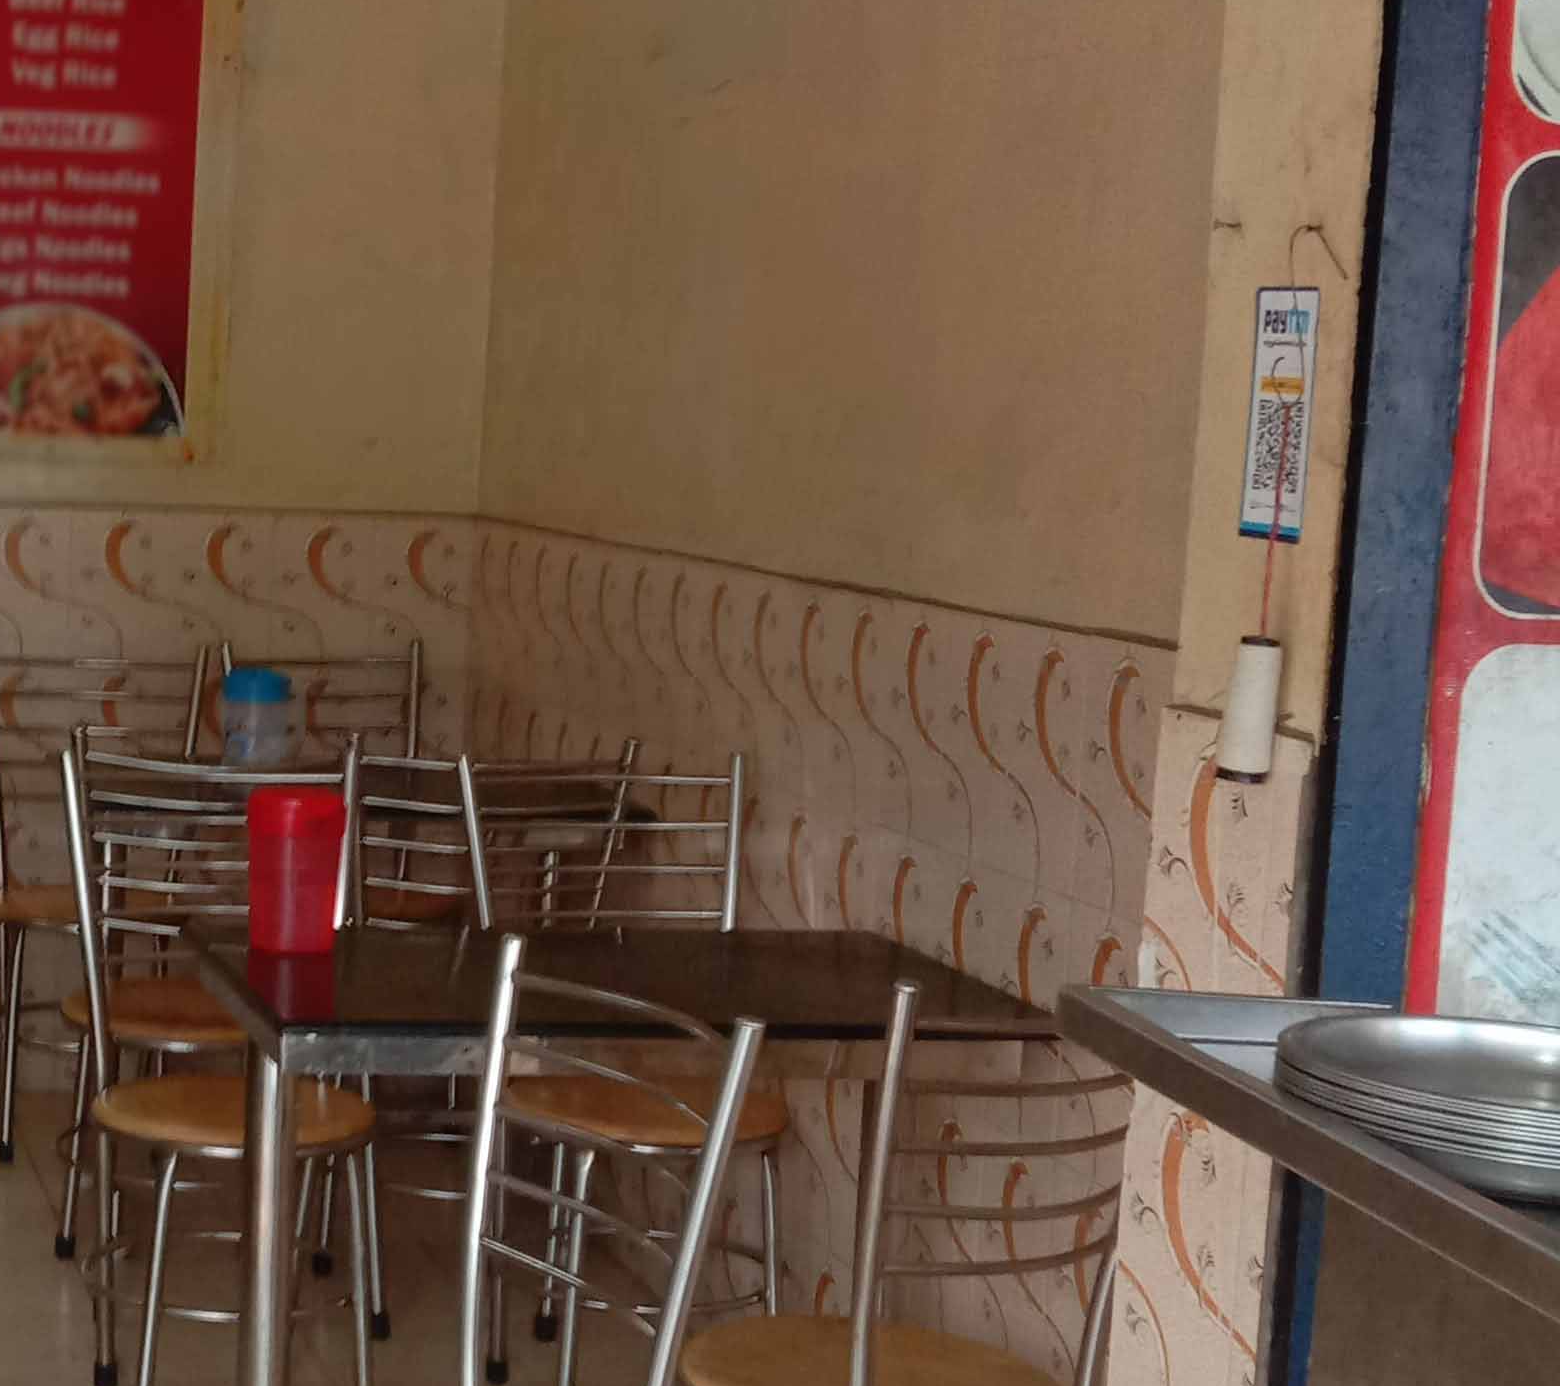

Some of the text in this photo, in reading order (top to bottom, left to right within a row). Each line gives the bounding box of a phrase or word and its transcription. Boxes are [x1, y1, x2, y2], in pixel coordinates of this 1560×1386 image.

[11, 19, 120, 54] Egg Rice
[10, 56, 118, 90] Veg Rice
[64, 163, 161, 195] Noodles
[42, 197, 138, 228] Noodles
[34, 231, 132, 263] Noodles
[33, 268, 130, 300] Noodles
